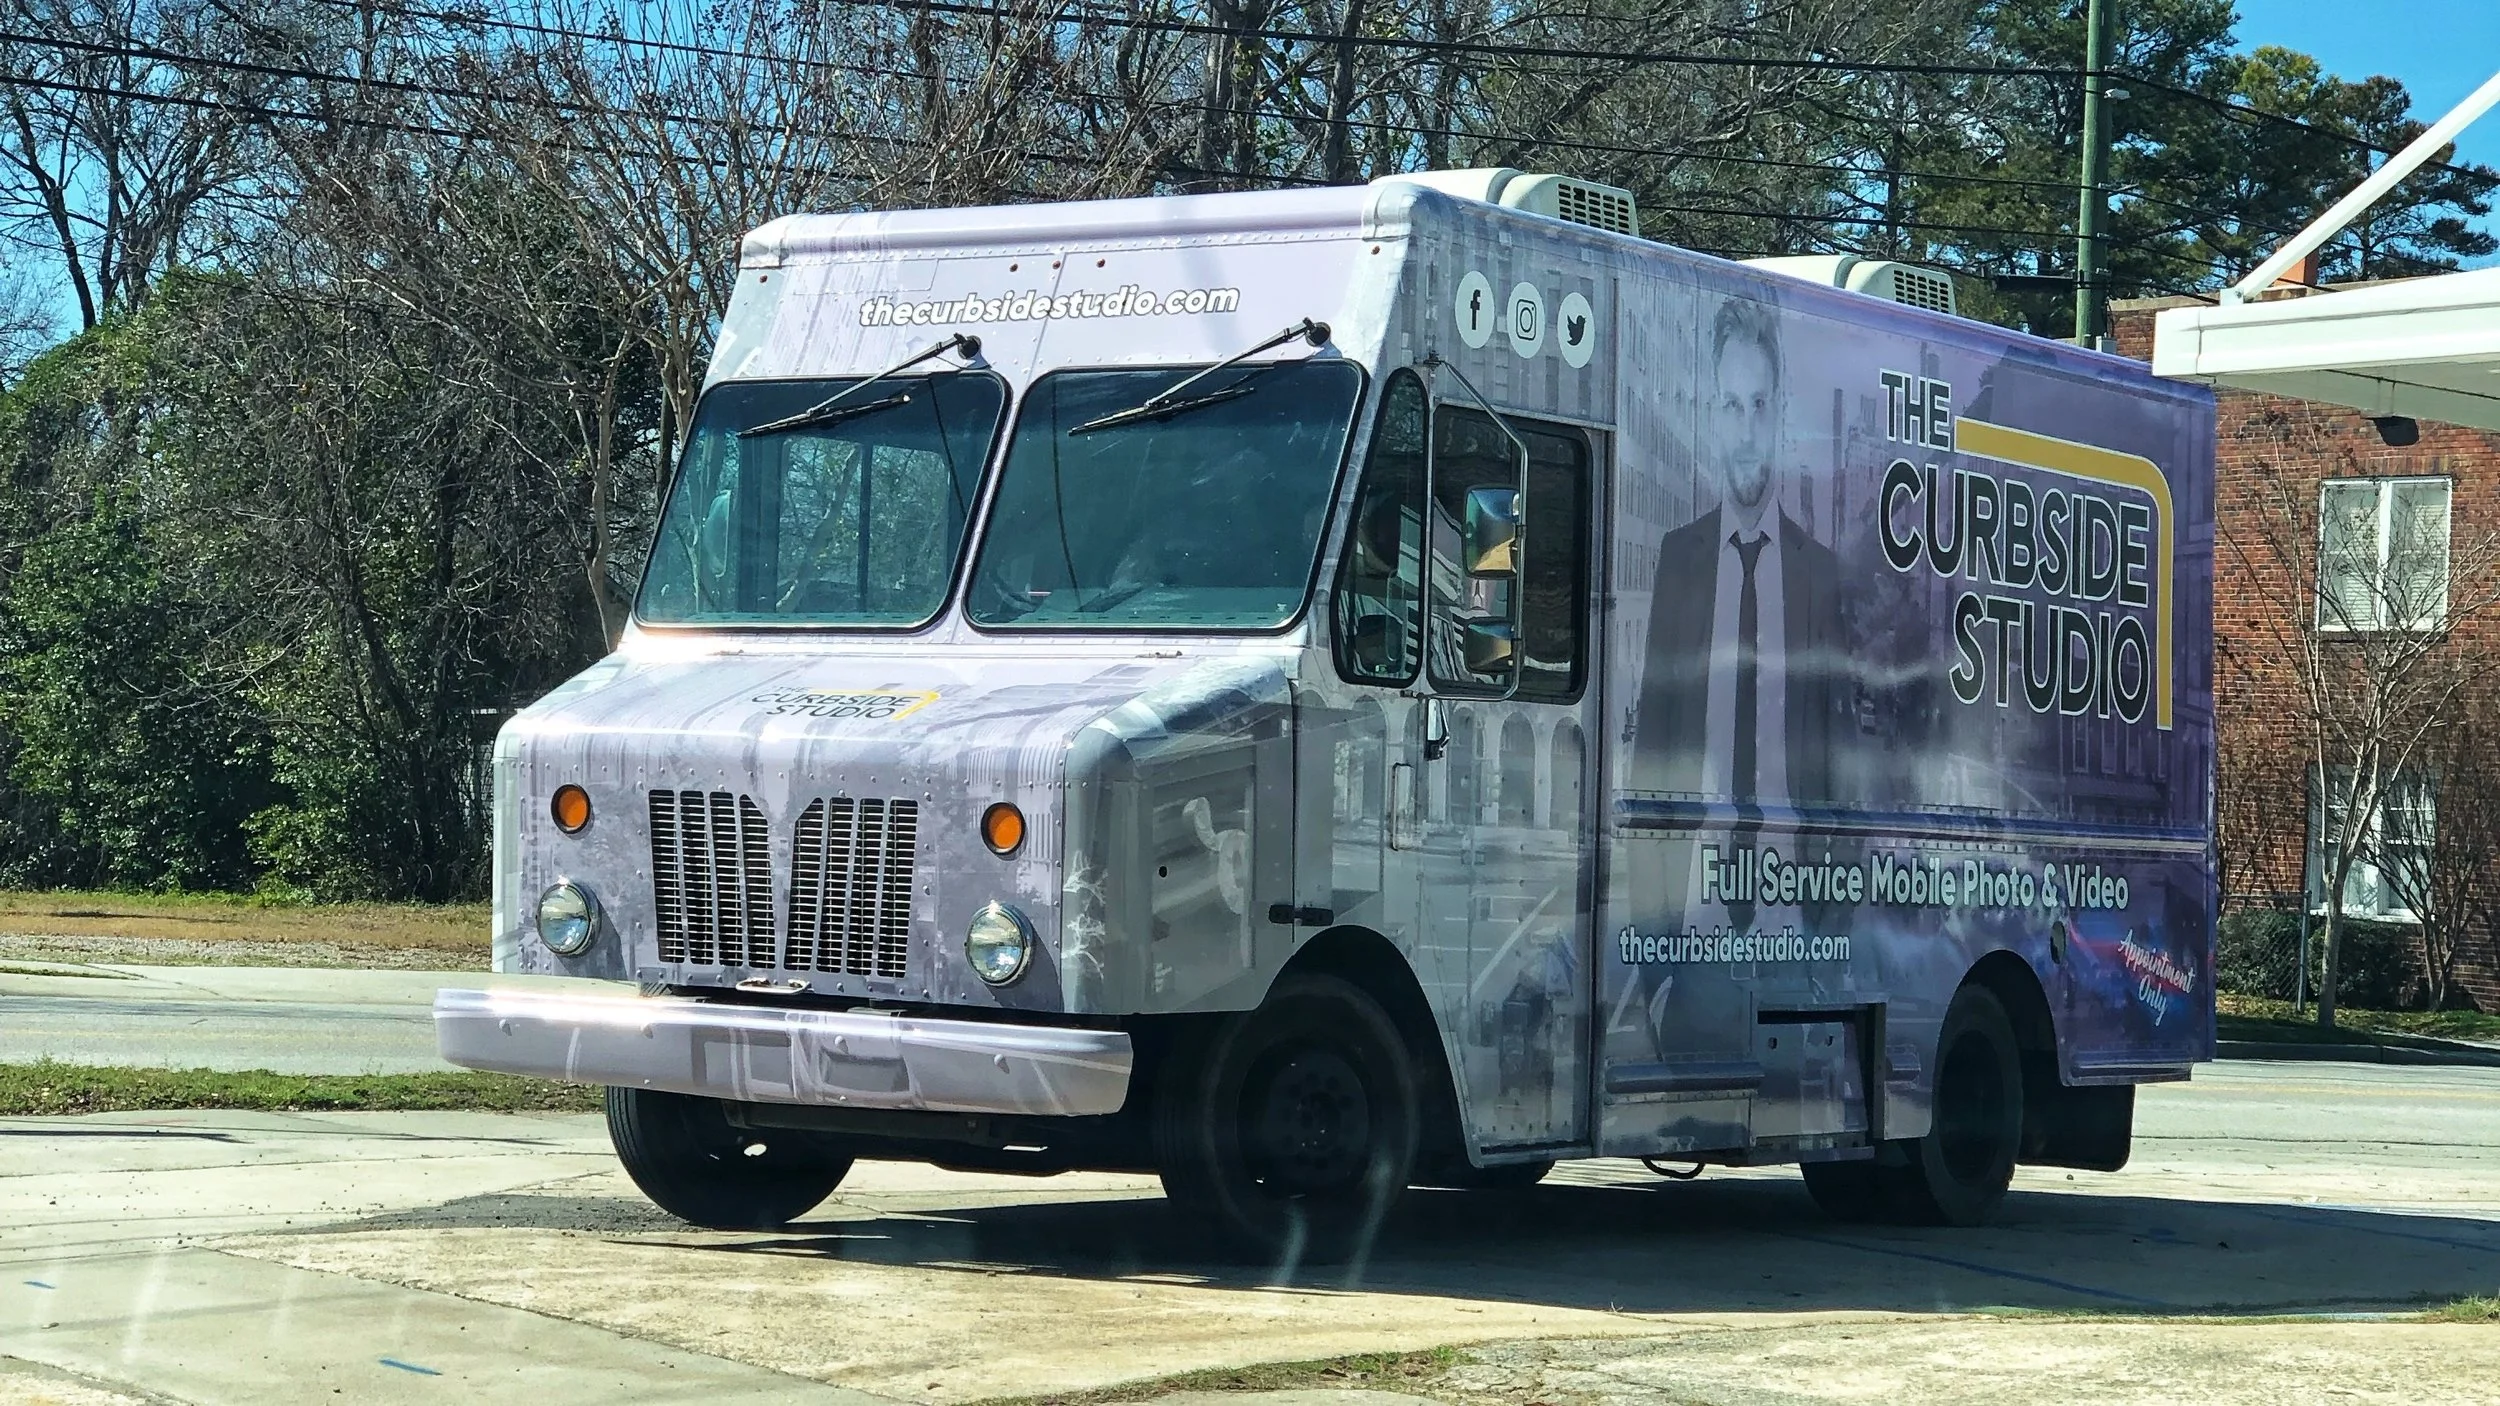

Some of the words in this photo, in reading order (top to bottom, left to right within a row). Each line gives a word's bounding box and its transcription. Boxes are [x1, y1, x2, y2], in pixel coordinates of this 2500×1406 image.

[859, 285, 1240, 326] thecurbsidestudio.com
[1879, 368, 1951, 452] THE
[1878, 458, 2150, 608] CURBSIDE
[1949, 591, 2150, 723] STUDIO
[752, 693, 920, 706] CURBSIDE
[766, 704, 896, 718] STUDIO
[1702, 847, 1753, 902] Full
[1761, 850, 1864, 904] Service
[1871, 855, 1956, 906] Mobile
[1963, 860, 2035, 907] Photo
[2041, 862, 2059, 908] &
[2064, 864, 2129, 909] Video
[1619, 926, 1850, 963] thecurbsidestudio.com
[2118, 929, 2195, 993] Appointment
[2139, 975, 2167, 1026] Only
